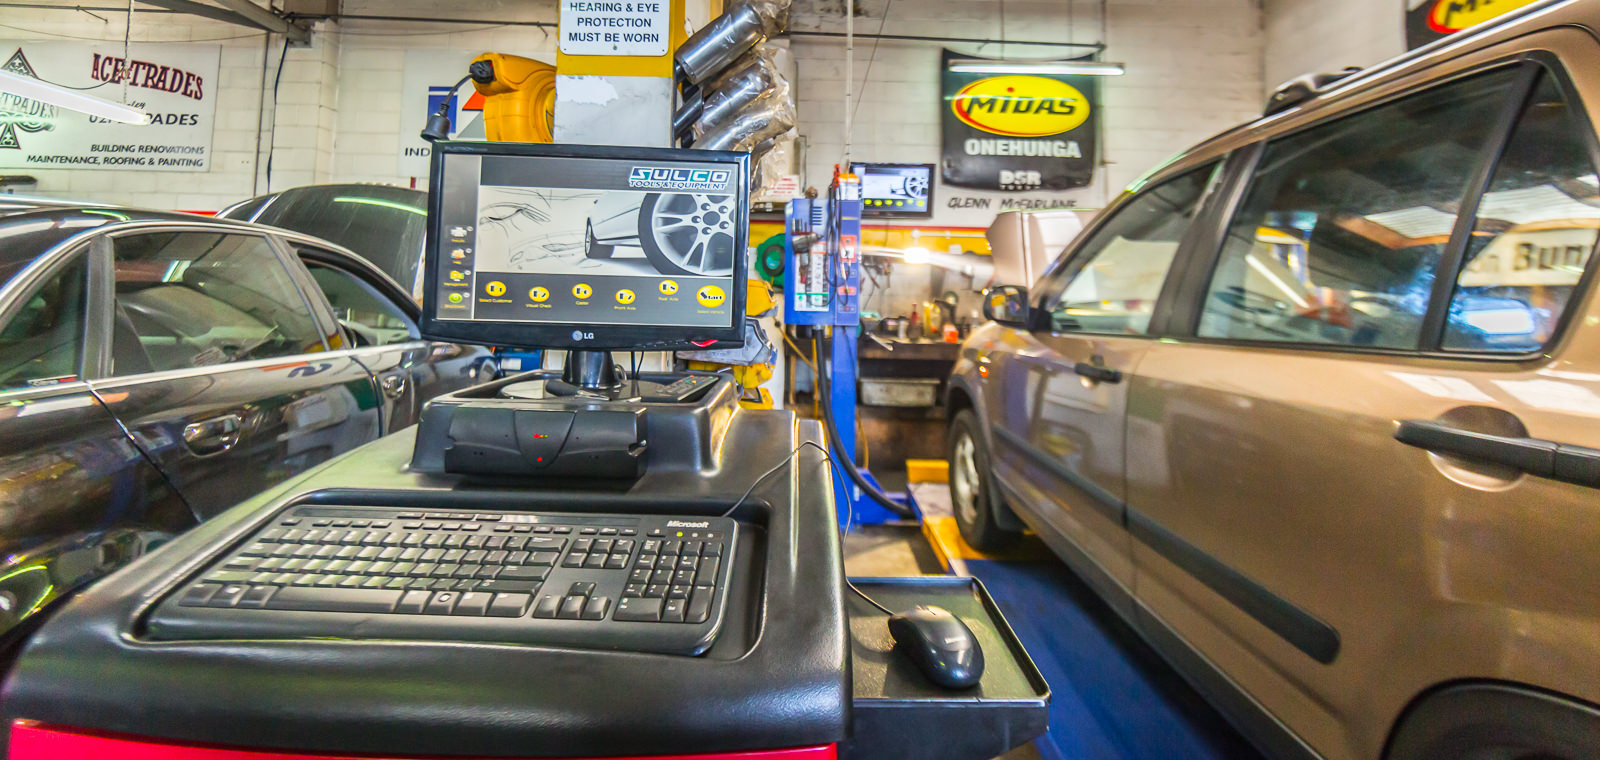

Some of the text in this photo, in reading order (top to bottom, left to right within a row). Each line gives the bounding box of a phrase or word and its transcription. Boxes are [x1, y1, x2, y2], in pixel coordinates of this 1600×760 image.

[570, 2, 660, 12] HEARING & EYE
[577, 17, 652, 27] PROTECTION
[568, 32, 659, 42] MUST BE WORN
[91, 53, 124, 84] ACE
[129, 59, 203, 101] TRADES
[91, 144, 204, 154] BUILDING RENOVATIONS
[964, 138, 1082, 158] ONEHUNGA
[27, 155, 203, 167] MAINTENANCE, ROOFING & PAINTING
[630, 168, 729, 183] SULCO
[1000, 170, 1042, 185] DSR
[948, 197, 992, 210] GLENN
[583, 332, 595, 340] LG
[666, 520, 710, 528] Microsoft
